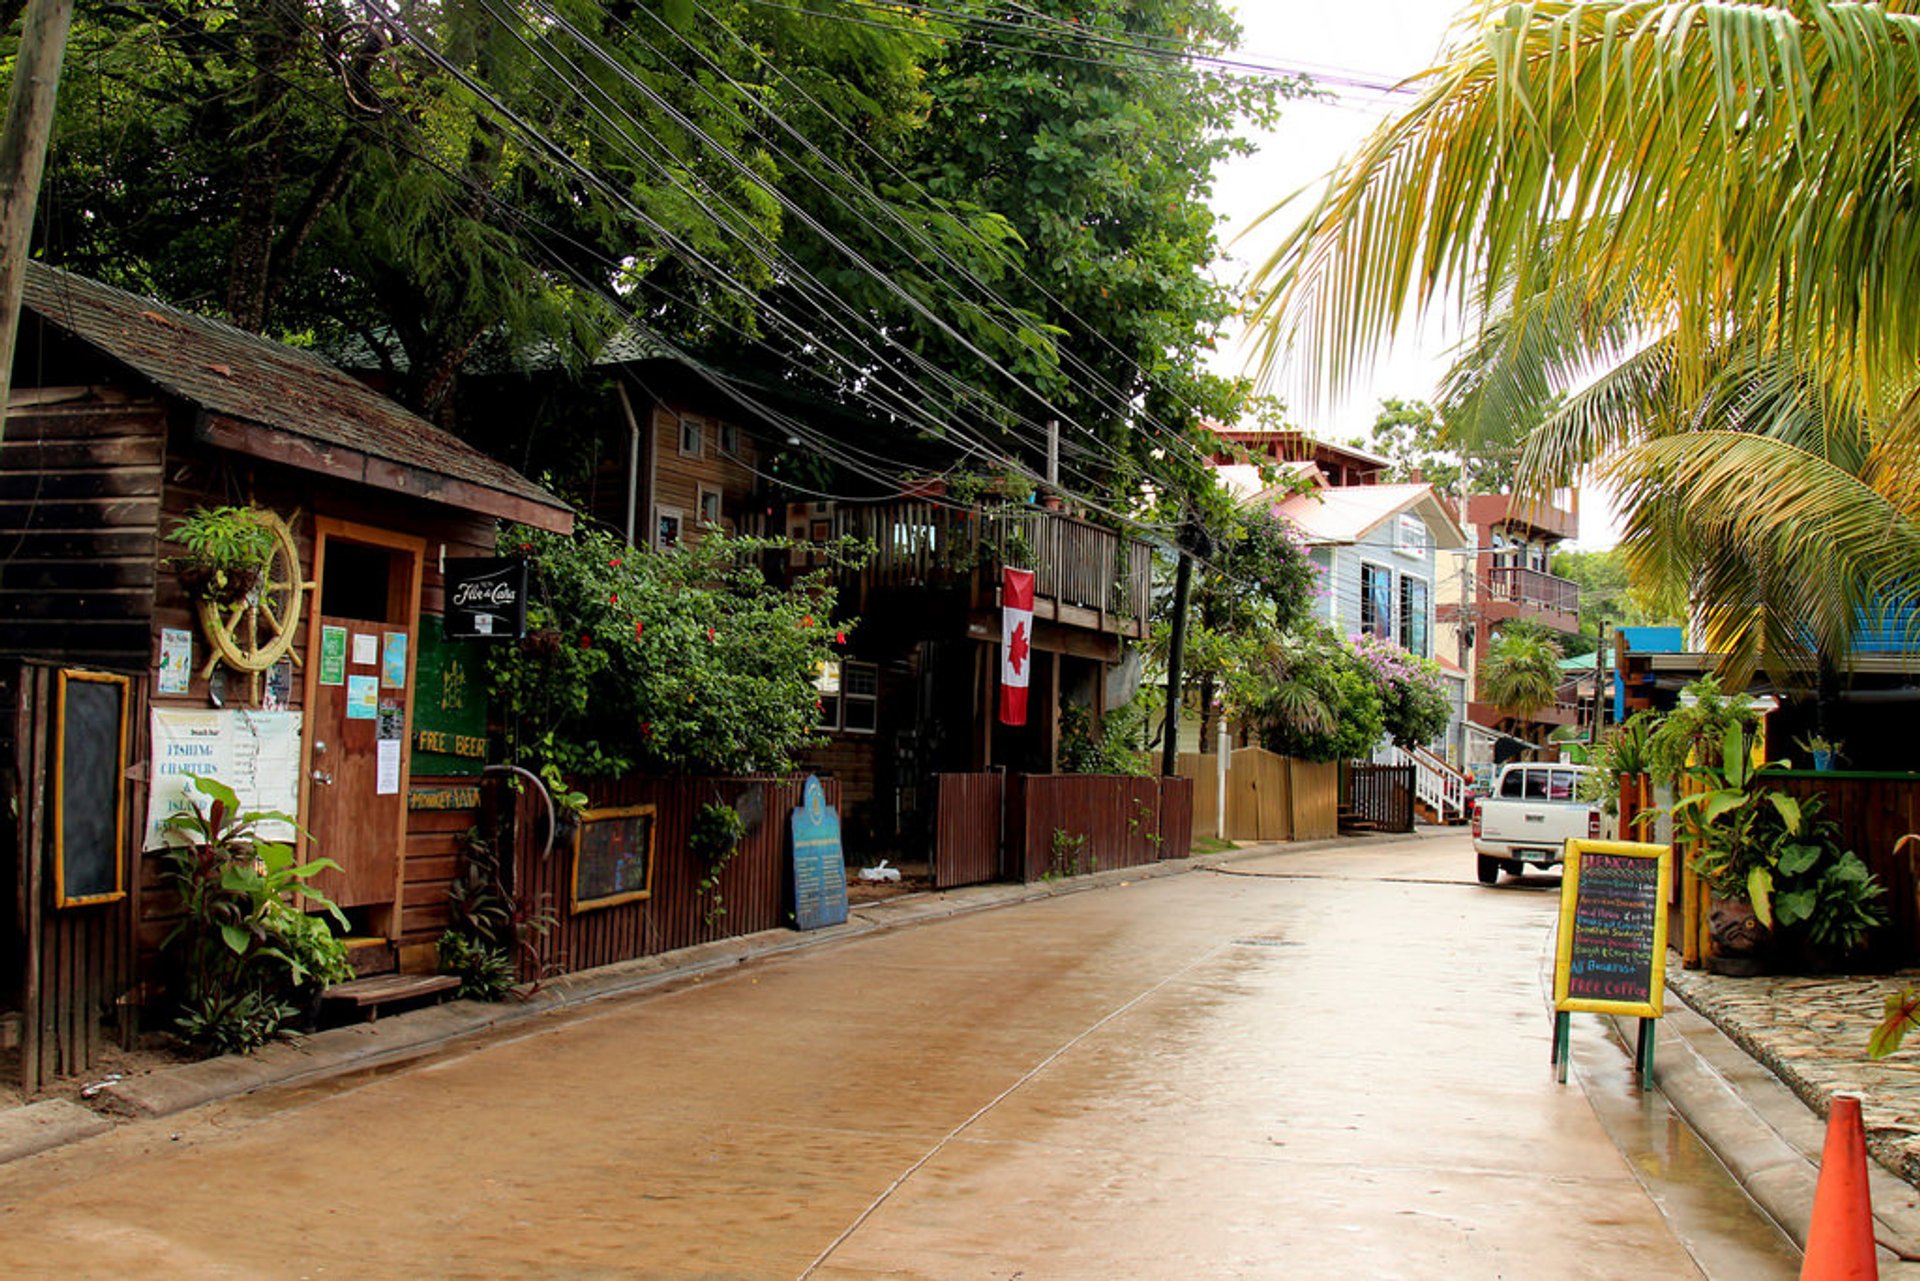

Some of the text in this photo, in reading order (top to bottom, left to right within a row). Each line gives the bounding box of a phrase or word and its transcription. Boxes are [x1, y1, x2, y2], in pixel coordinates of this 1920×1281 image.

[419, 730, 446, 753] FREE
[167, 744, 213, 756] FISHING
[161, 763, 218, 775] CHARTERS
